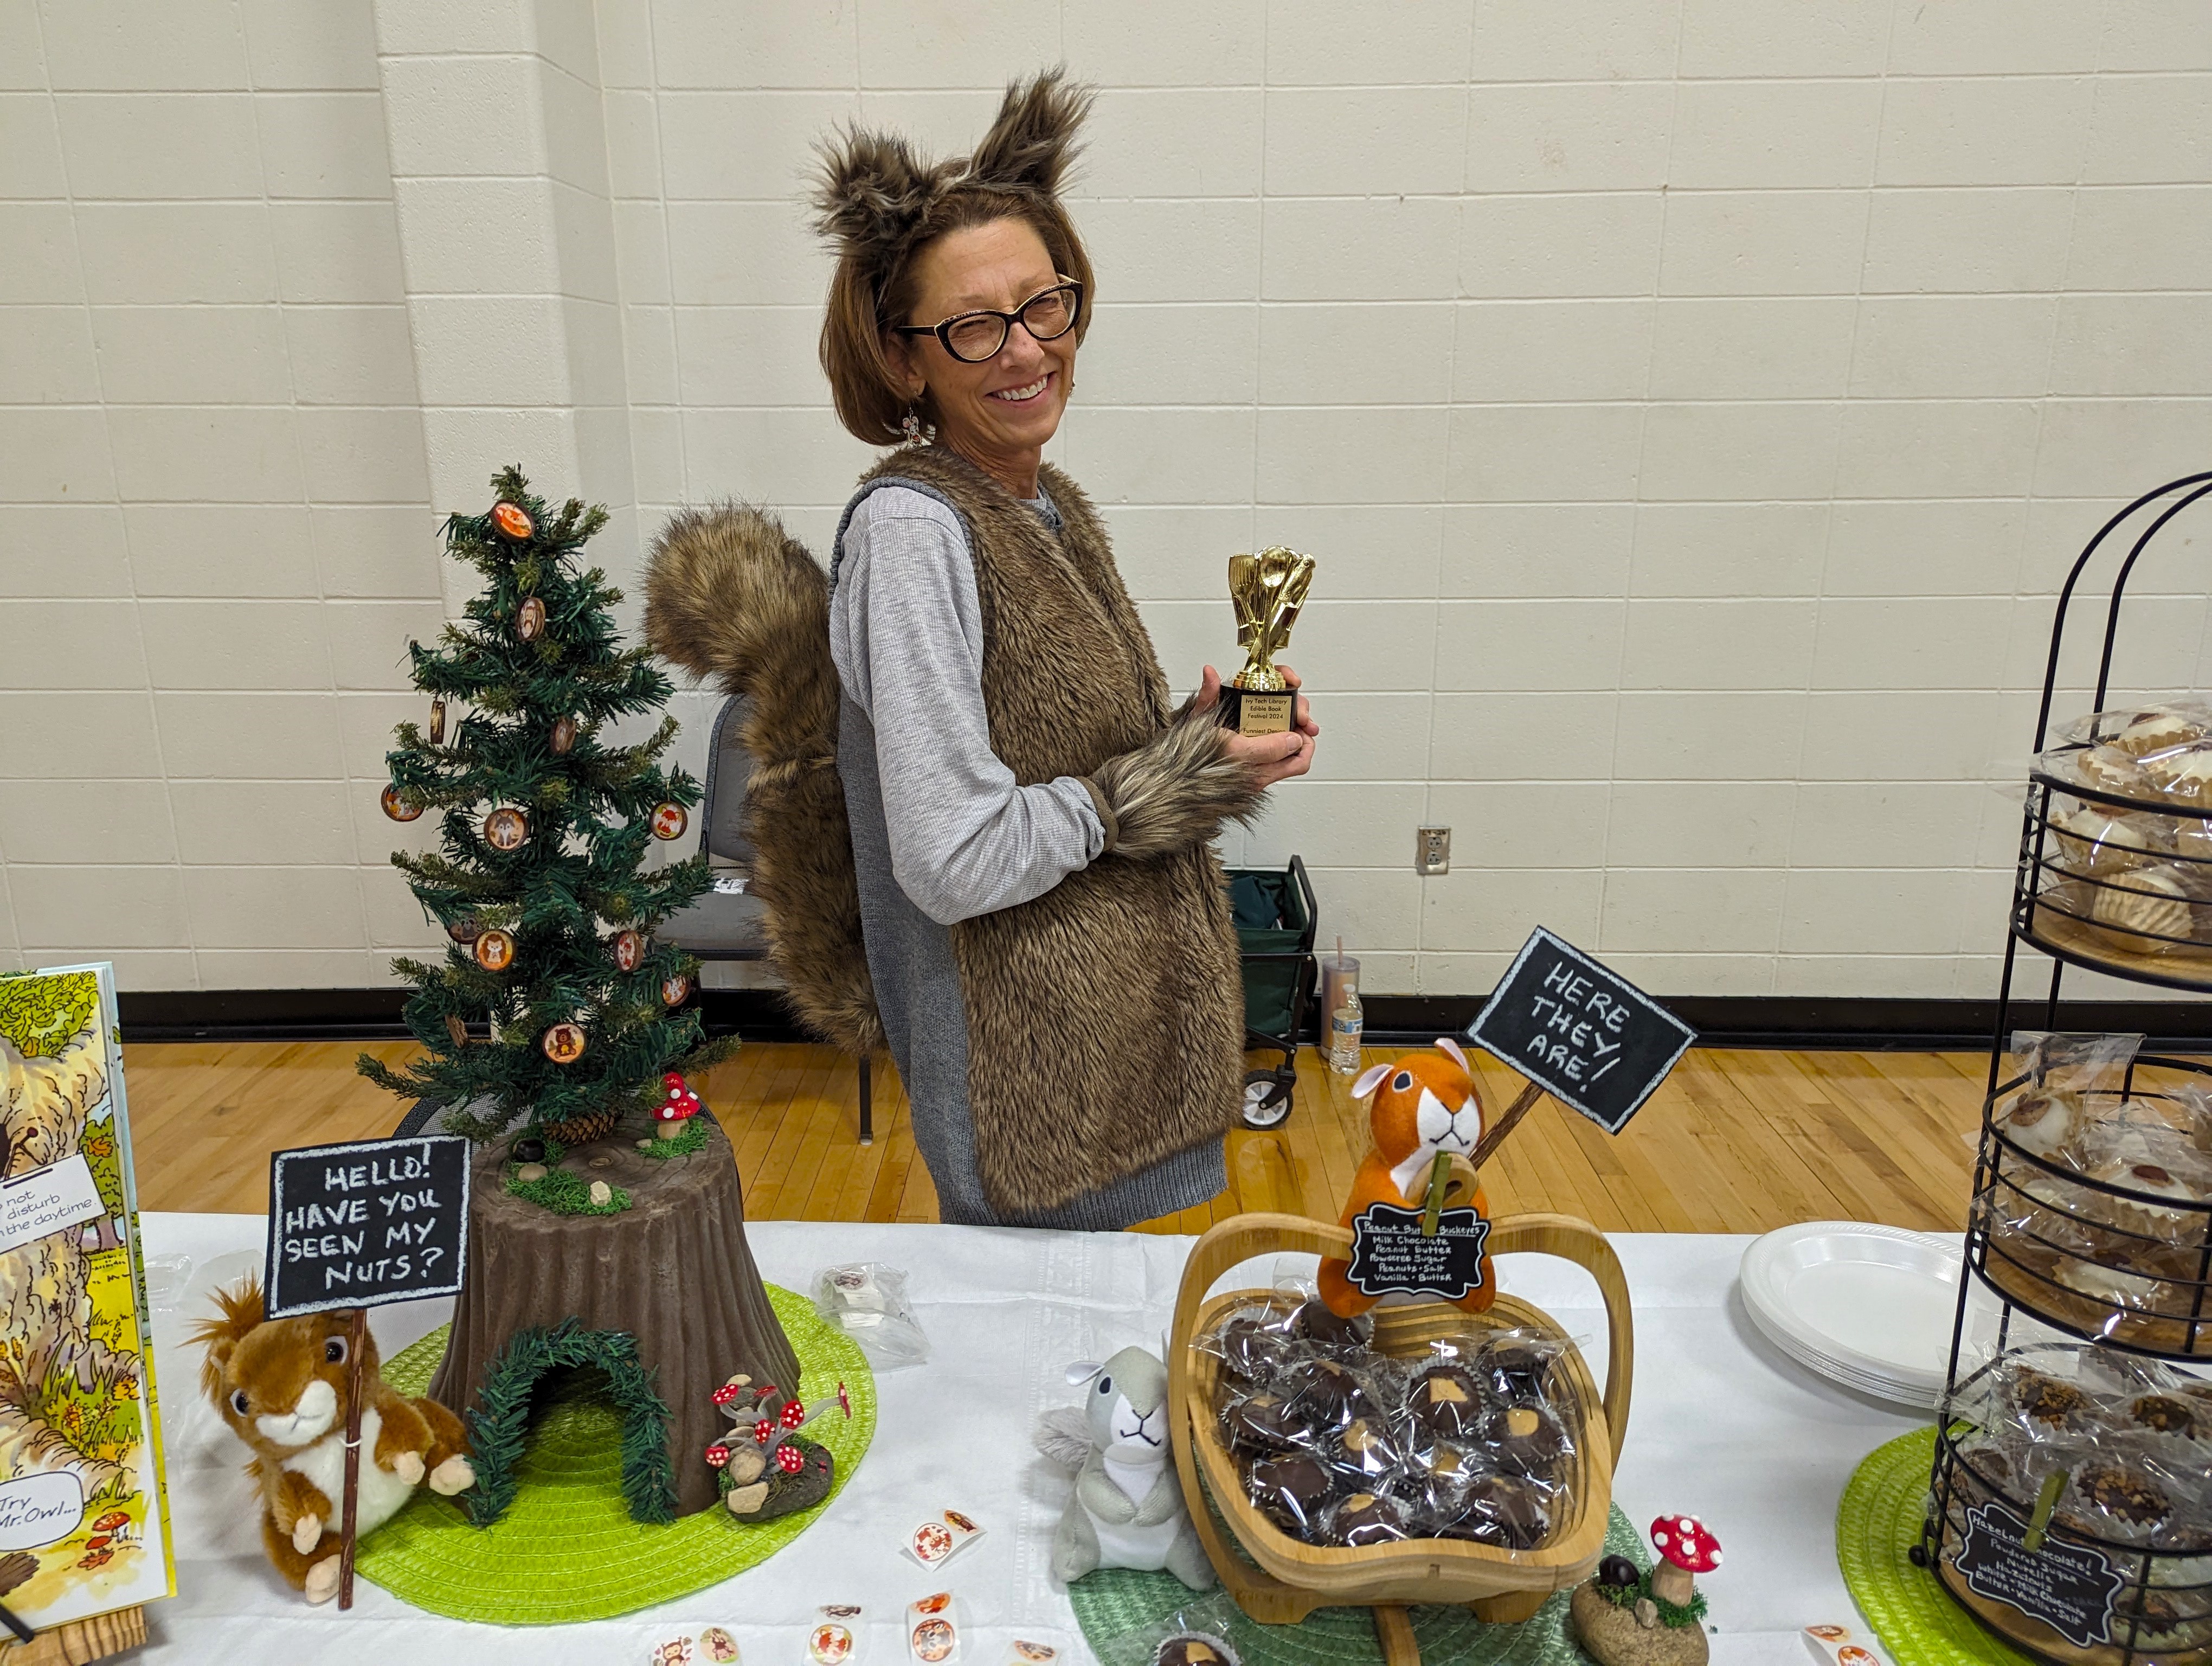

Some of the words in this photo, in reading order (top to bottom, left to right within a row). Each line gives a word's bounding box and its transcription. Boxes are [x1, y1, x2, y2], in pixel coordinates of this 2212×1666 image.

[1544, 961, 1630, 1033] HERE
[1531, 995, 1621, 1058] THEY
[1527, 1034, 1621, 1093] ARE!
[325, 1143, 431, 1191] HELLO!
[7, 1191, 35, 1206] not
[7, 1194, 60, 1219] disturb
[6, 1221, 29, 1235] the
[34, 1199, 97, 1225] daytime.
[285, 1199, 370, 1234] HAVE
[378, 1189, 442, 1216] YOU
[285, 1230, 364, 1263] SEEN
[385, 1217, 436, 1248] MY
[1364, 1221, 1398, 1232] Peanut
[1439, 1225, 1480, 1236] Buckeyes
[1372, 1235, 1393, 1244] Milk
[1397, 1235, 1449, 1246] Chocolate
[1375, 1244, 1409, 1254] Peanut
[1414, 1254, 1447, 1265] Sugar
[325, 1247, 444, 1290] NUTS?
[1373, 1273, 1410, 1281] Vanilla
[1423, 1264, 1445, 1273] Salt
[0, 1496, 31, 1511] Try
